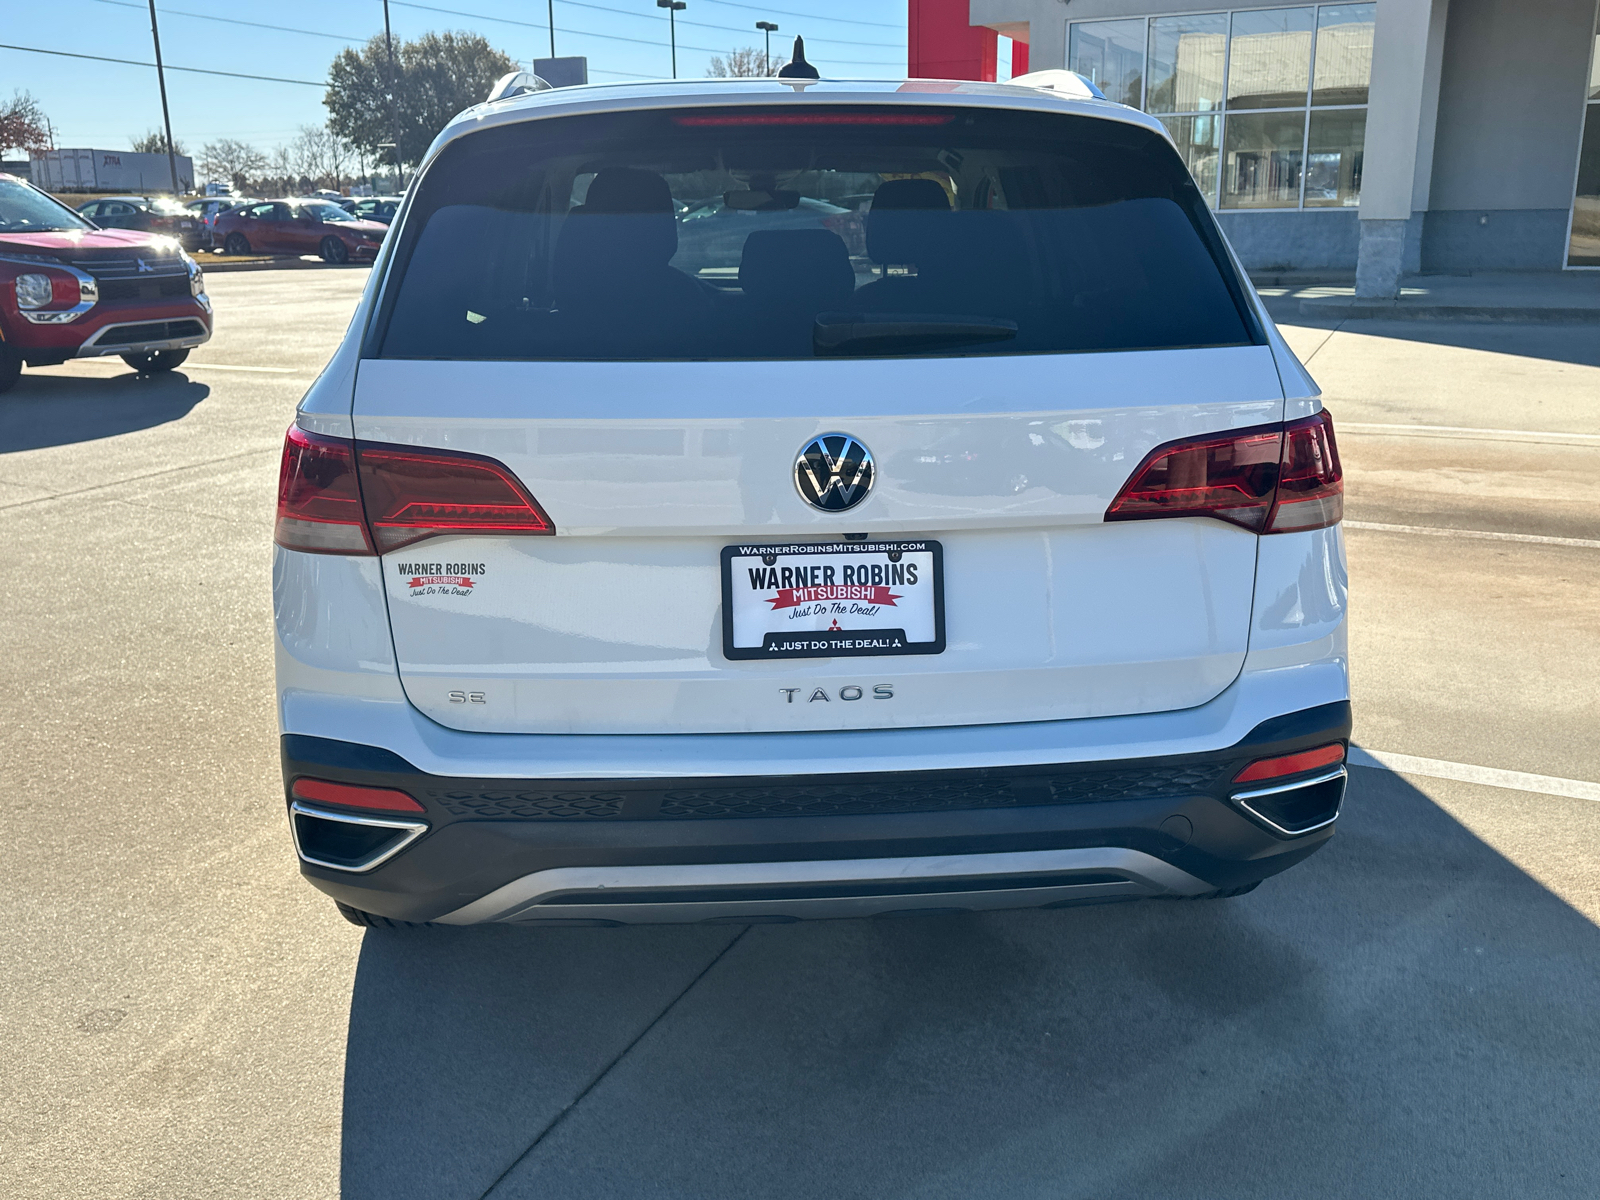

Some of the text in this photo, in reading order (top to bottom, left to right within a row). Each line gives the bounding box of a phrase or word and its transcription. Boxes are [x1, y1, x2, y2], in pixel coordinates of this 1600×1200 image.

[398, 563, 486, 575] WARNER ROBINS
[420, 576, 463, 584] MITSUBISHI
[748, 562, 918, 590] WARNER ROBINS
[410, 586, 473, 597] Just Do The Deal!
[793, 586, 875, 602] MITSUBISHI
[789, 602, 880, 619] Just Do The Deal!
[780, 639, 890, 651] JUST DO THE DEAL!
[448, 691, 486, 704] SE
[779, 683, 894, 703] TAOS
